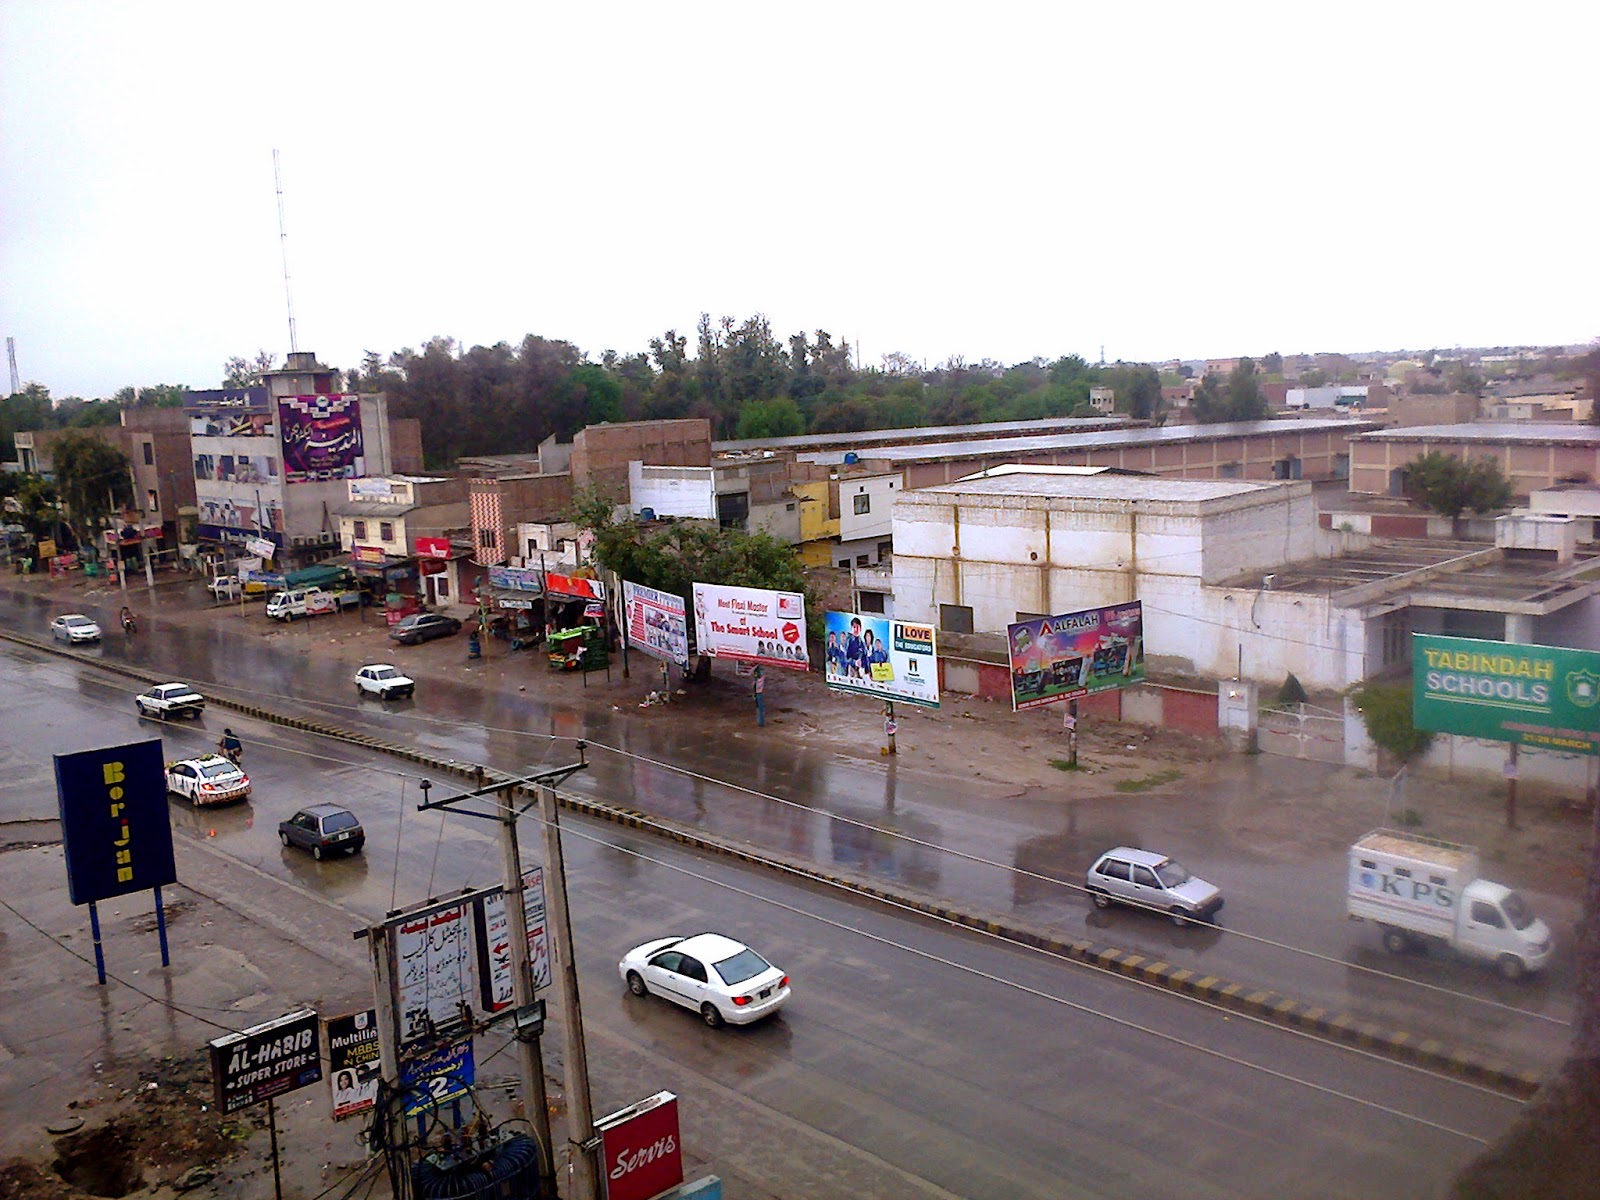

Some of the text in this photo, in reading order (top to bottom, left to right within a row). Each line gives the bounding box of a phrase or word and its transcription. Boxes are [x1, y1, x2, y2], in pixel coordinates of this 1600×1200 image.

[711, 621, 725, 632] The
[727, 623, 750, 636] Smart
[752, 626, 778, 640] School
[905, 628, 930, 640] LOVE
[1054, 614, 1099, 632] ALFALAH
[1424, 649, 1554, 681] TABINDAH
[1426, 672, 1549, 704] SCHOOLS
[103, 761, 134, 883] Borjan
[228, 1029, 313, 1075] AL-HABIB
[331, 1029, 378, 1049] Multilin
[236, 1066, 271, 1089] SUPER
[274, 1053, 307, 1075] STORE
[355, 1051, 379, 1064] CHIN
[428, 1076, 449, 1099] 2
[610, 1134, 676, 1180] Servis
